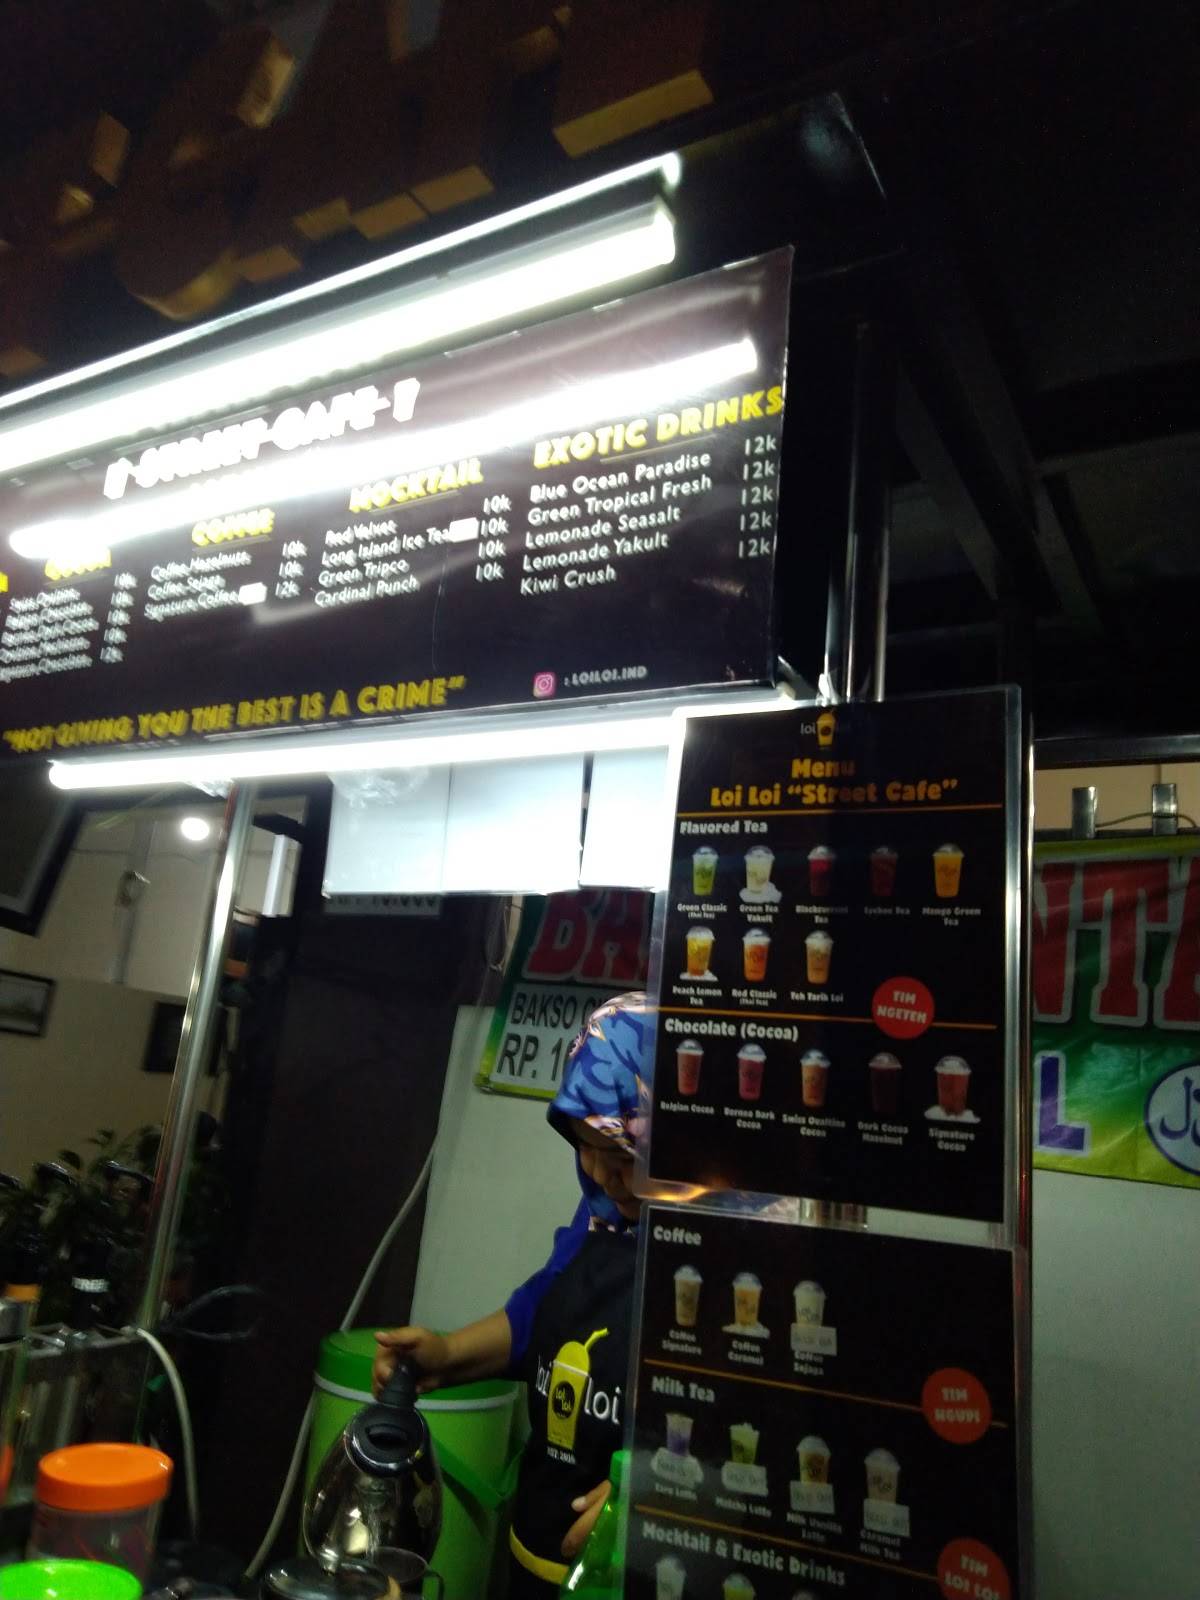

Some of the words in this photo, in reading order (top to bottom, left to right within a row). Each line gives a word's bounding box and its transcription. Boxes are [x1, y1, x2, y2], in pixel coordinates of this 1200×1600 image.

[533, 419, 648, 469] EXOTIC
[656, 386, 783, 442] DRINKS
[349, 457, 483, 513] MOCKTAIL
[530, 483, 568, 503] Blue
[572, 473, 629, 495] Ocean
[635, 453, 711, 482] Paradise
[744, 434, 777, 456] 12k
[483, 493, 512, 515] 10k
[525, 518, 613, 550] Lemonade
[618, 504, 681, 533] Seasalt
[741, 486, 774, 506] 12k
[528, 506, 581, 526] Green
[585, 486, 657, 515] Tropical
[662, 474, 712, 500] Fresh
[743, 461, 775, 480] 12k
[318, 570, 363, 588] Green
[478, 539, 507, 559] 10k
[322, 549, 358, 568] Long
[358, 536, 402, 560] Island
[402, 533, 426, 550] Ice
[426, 526, 451, 545] Tea
[480, 517, 510, 536] 10k
[522, 542, 611, 573] Lemonade
[613, 530, 670, 557] Yakult
[739, 512, 772, 532] 12k
[314, 581, 374, 608] Cardinal
[376, 574, 421, 596] Punch
[475, 562, 504, 583] 10k
[520, 574, 560, 597] Kiwi
[564, 563, 618, 590] Crush
[737, 538, 771, 559] 12k
[137, 709, 189, 739] YOU
[191, 703, 236, 734] THE
[236, 695, 296, 728] BEST
[300, 691, 326, 721] IS
[329, 689, 350, 717] A
[790, 757, 856, 780] Menu
[709, 784, 744, 808] Loi
[748, 782, 782, 807] Loi
[679, 820, 740, 835] Flavored
[743, 819, 769, 834] Tea
[511, 992, 577, 1030] BAKSO
[664, 1017, 737, 1037] Chocolate
[740, 1021, 799, 1043] (Cocoa)
[497, 1033, 539, 1079] RP.
[652, 1224, 703, 1247] Coffee
[584, 1376, 621, 1426] loi
[651, 1375, 686, 1398] Milk
[688, 1381, 717, 1404] Tea
[641, 1520, 712, 1554] Mocktail
[714, 1536, 730, 1557] &
[732, 1541, 785, 1571] Exotic
[788, 1559, 847, 1588] Drinks
